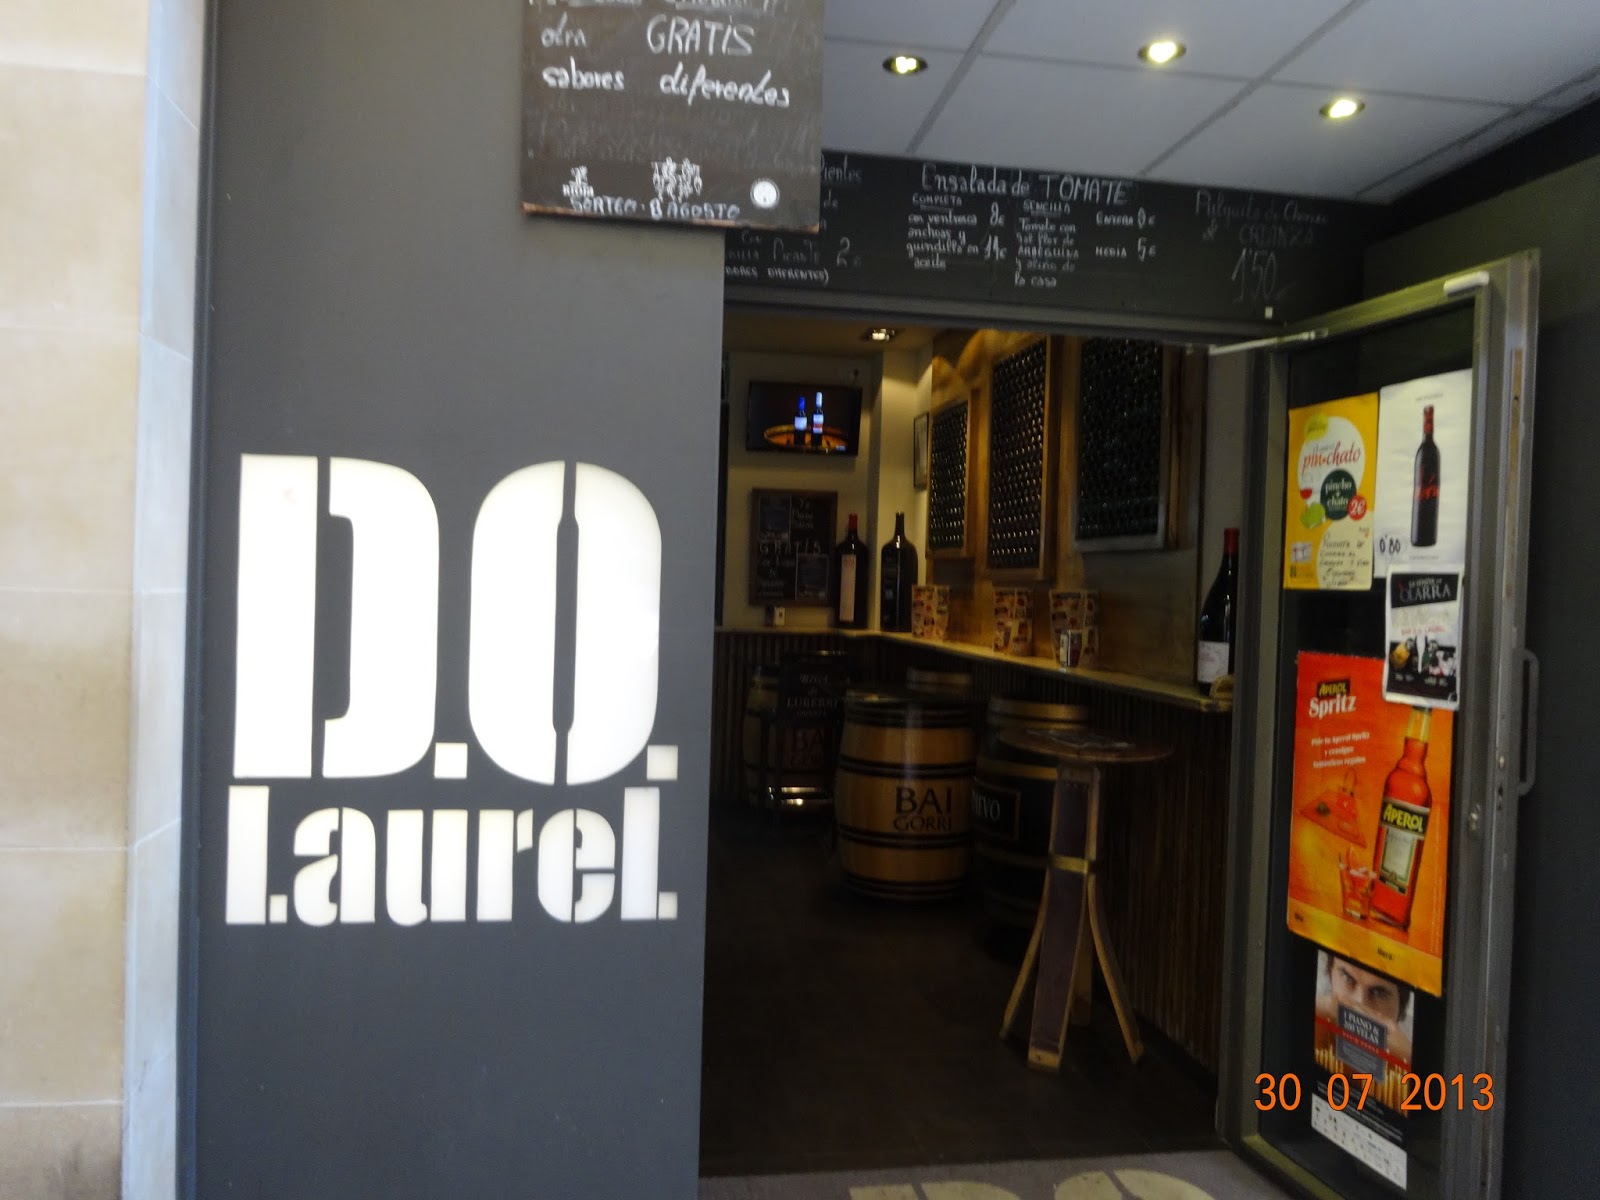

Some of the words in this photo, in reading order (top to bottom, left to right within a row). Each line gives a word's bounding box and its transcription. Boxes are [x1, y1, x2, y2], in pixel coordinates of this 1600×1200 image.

[647, 14, 755, 55] GRATIS
[542, 56, 625, 90] sabores
[659, 61, 790, 107] diferentes
[922, 162, 1007, 195] Ensalada
[1011, 169, 1030, 197] de
[1039, 174, 1132, 206] TOMATE
[1030, 275, 1057, 288] casa
[233, 454, 679, 786] D.O.
[1309, 694, 1356, 719] Spritz
[1384, 803, 1423, 832] APEROL
